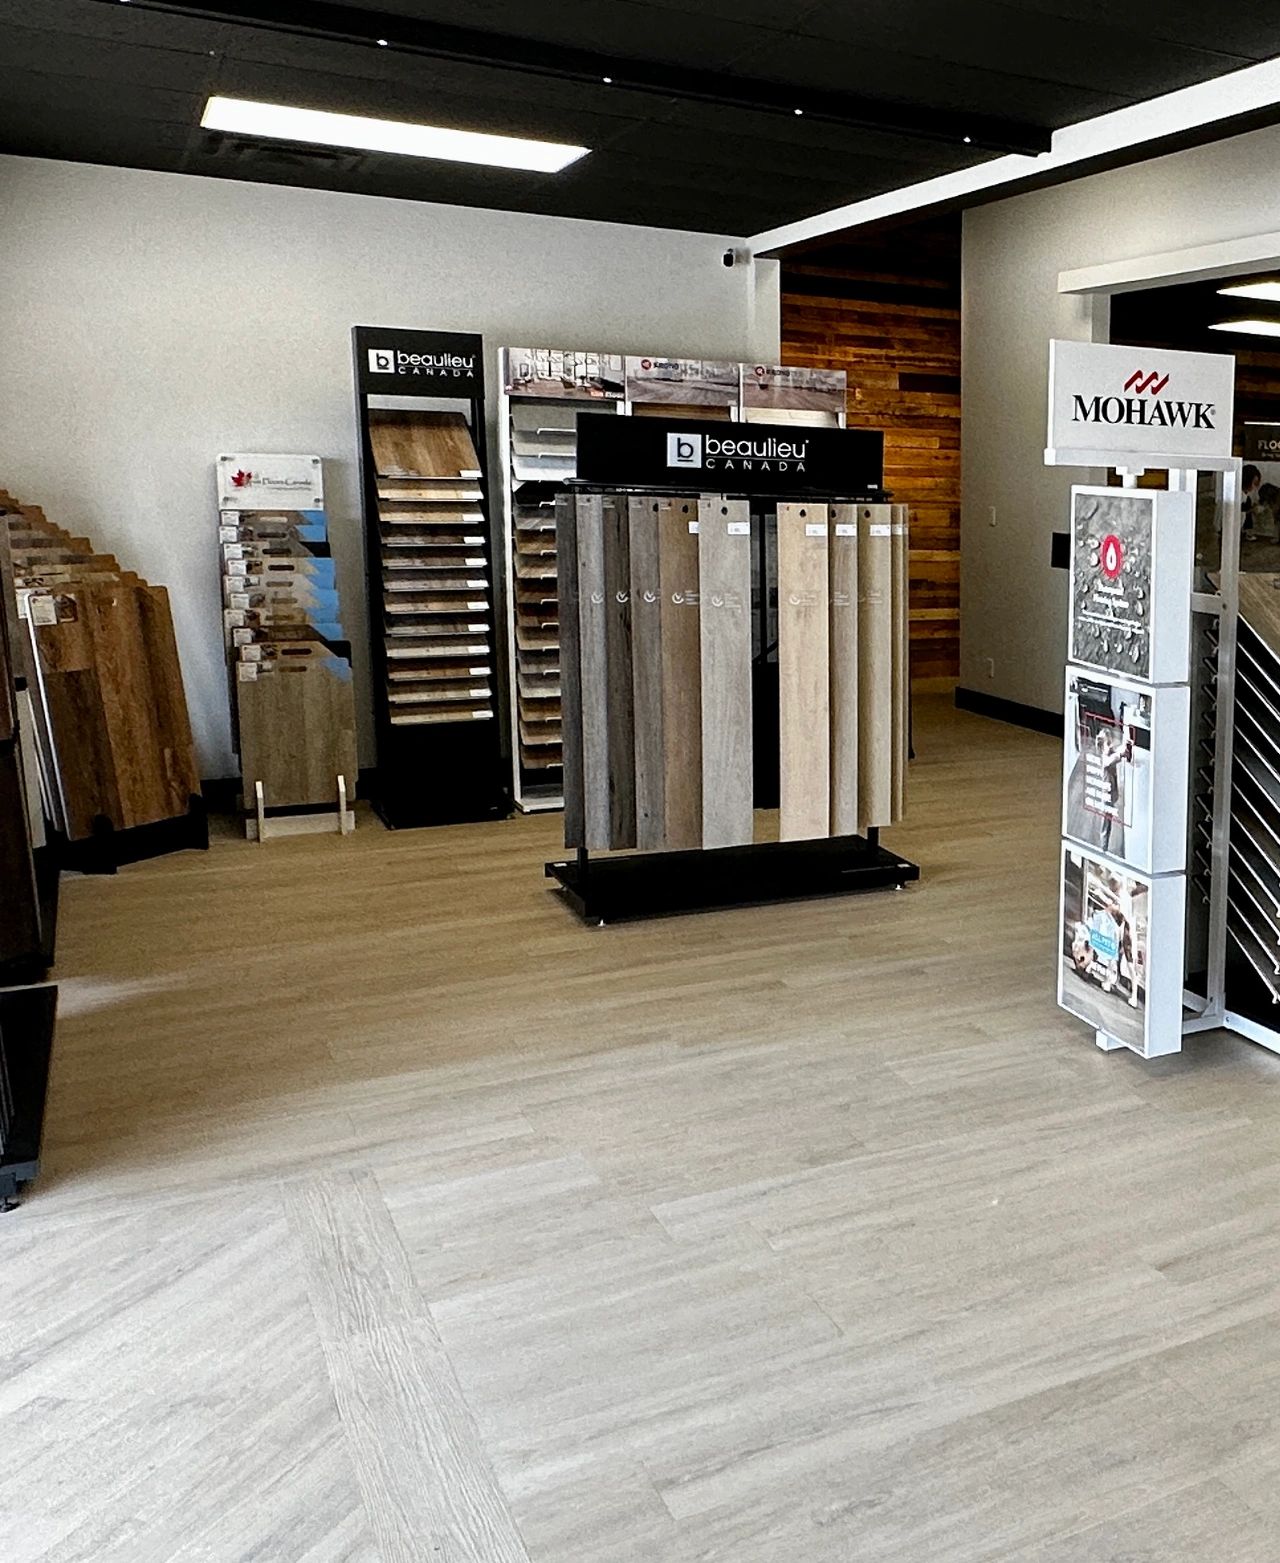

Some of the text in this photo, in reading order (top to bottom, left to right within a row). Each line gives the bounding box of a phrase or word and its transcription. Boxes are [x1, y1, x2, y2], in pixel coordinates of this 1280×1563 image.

[397, 349, 474, 369] beaulieu
[398, 366, 475, 378] CANADA
[1072, 394, 1216, 430] MOHAWK
[705, 434, 806, 459] beaulieu
[705, 458, 806, 472] CANADA
